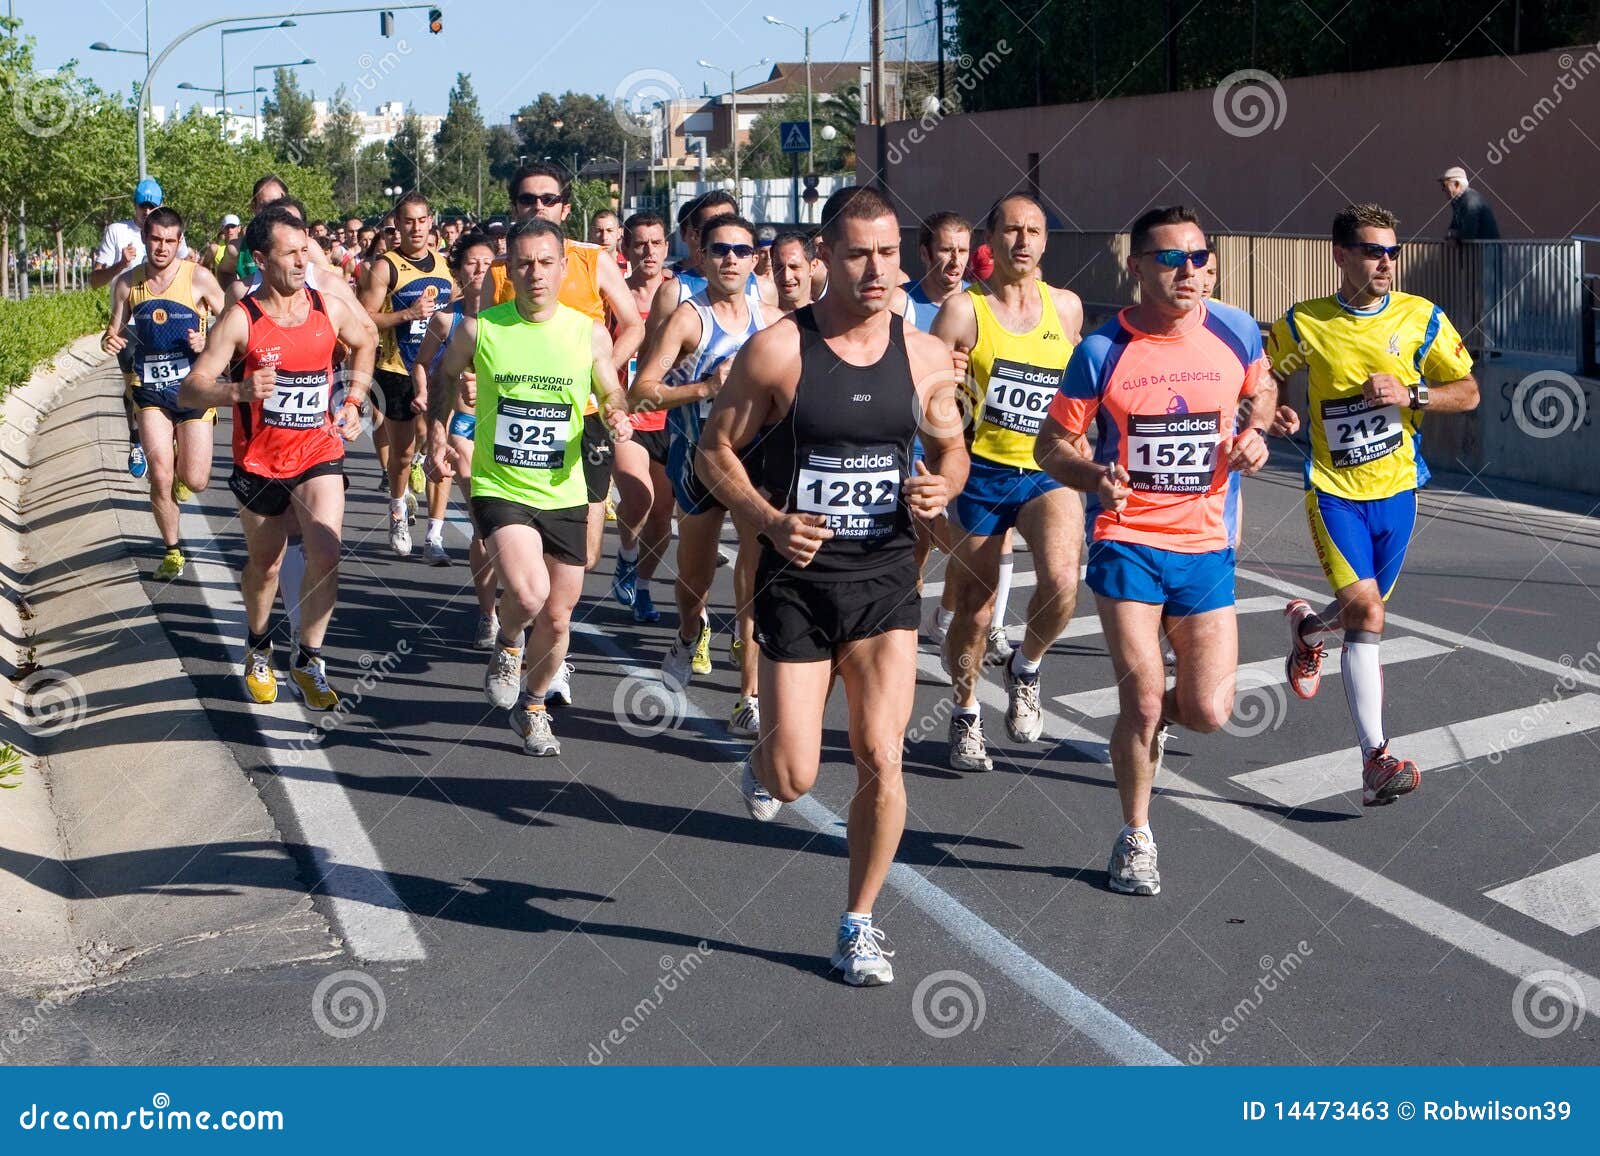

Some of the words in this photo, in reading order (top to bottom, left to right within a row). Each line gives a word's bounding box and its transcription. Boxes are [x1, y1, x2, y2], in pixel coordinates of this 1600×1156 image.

[151, 363, 180, 379] 831
[294, 374, 327, 385] adidas
[494, 374, 574, 386] RUNNERSWORLD
[1024, 372, 1059, 385] adidas
[1122, 377, 1148, 390] CLUB
[1151, 375, 1166, 384] DA
[1169, 372, 1221, 382] CLENCHIS
[530, 384, 563, 392] ALZIRA
[277, 391, 321, 409] 714
[280, 413, 292, 422] 15
[295, 413, 314, 423] km
[528, 407, 568, 419] adidas
[1002, 412, 1016, 423] 15
[1018, 415, 1040, 429] km
[1168, 419, 1217, 432] adidas
[508, 423, 556, 446] 925
[1337, 414, 1388, 444] 212
[511, 450, 525, 460] 15
[528, 450, 549, 462] km
[1136, 442, 1216, 466] 1527
[1348, 449, 1361, 458] 15
[1366, 442, 1387, 454] km
[496, 454, 508, 463] Villa
[844, 454, 894, 469] adidas
[1132, 482, 1150, 490] Villa
[1152, 474, 1168, 485] 15
[1174, 474, 1200, 485] km
[806, 479, 894, 507] 1282
[826, 516, 842, 528] 15
[847, 514, 875, 528] km
